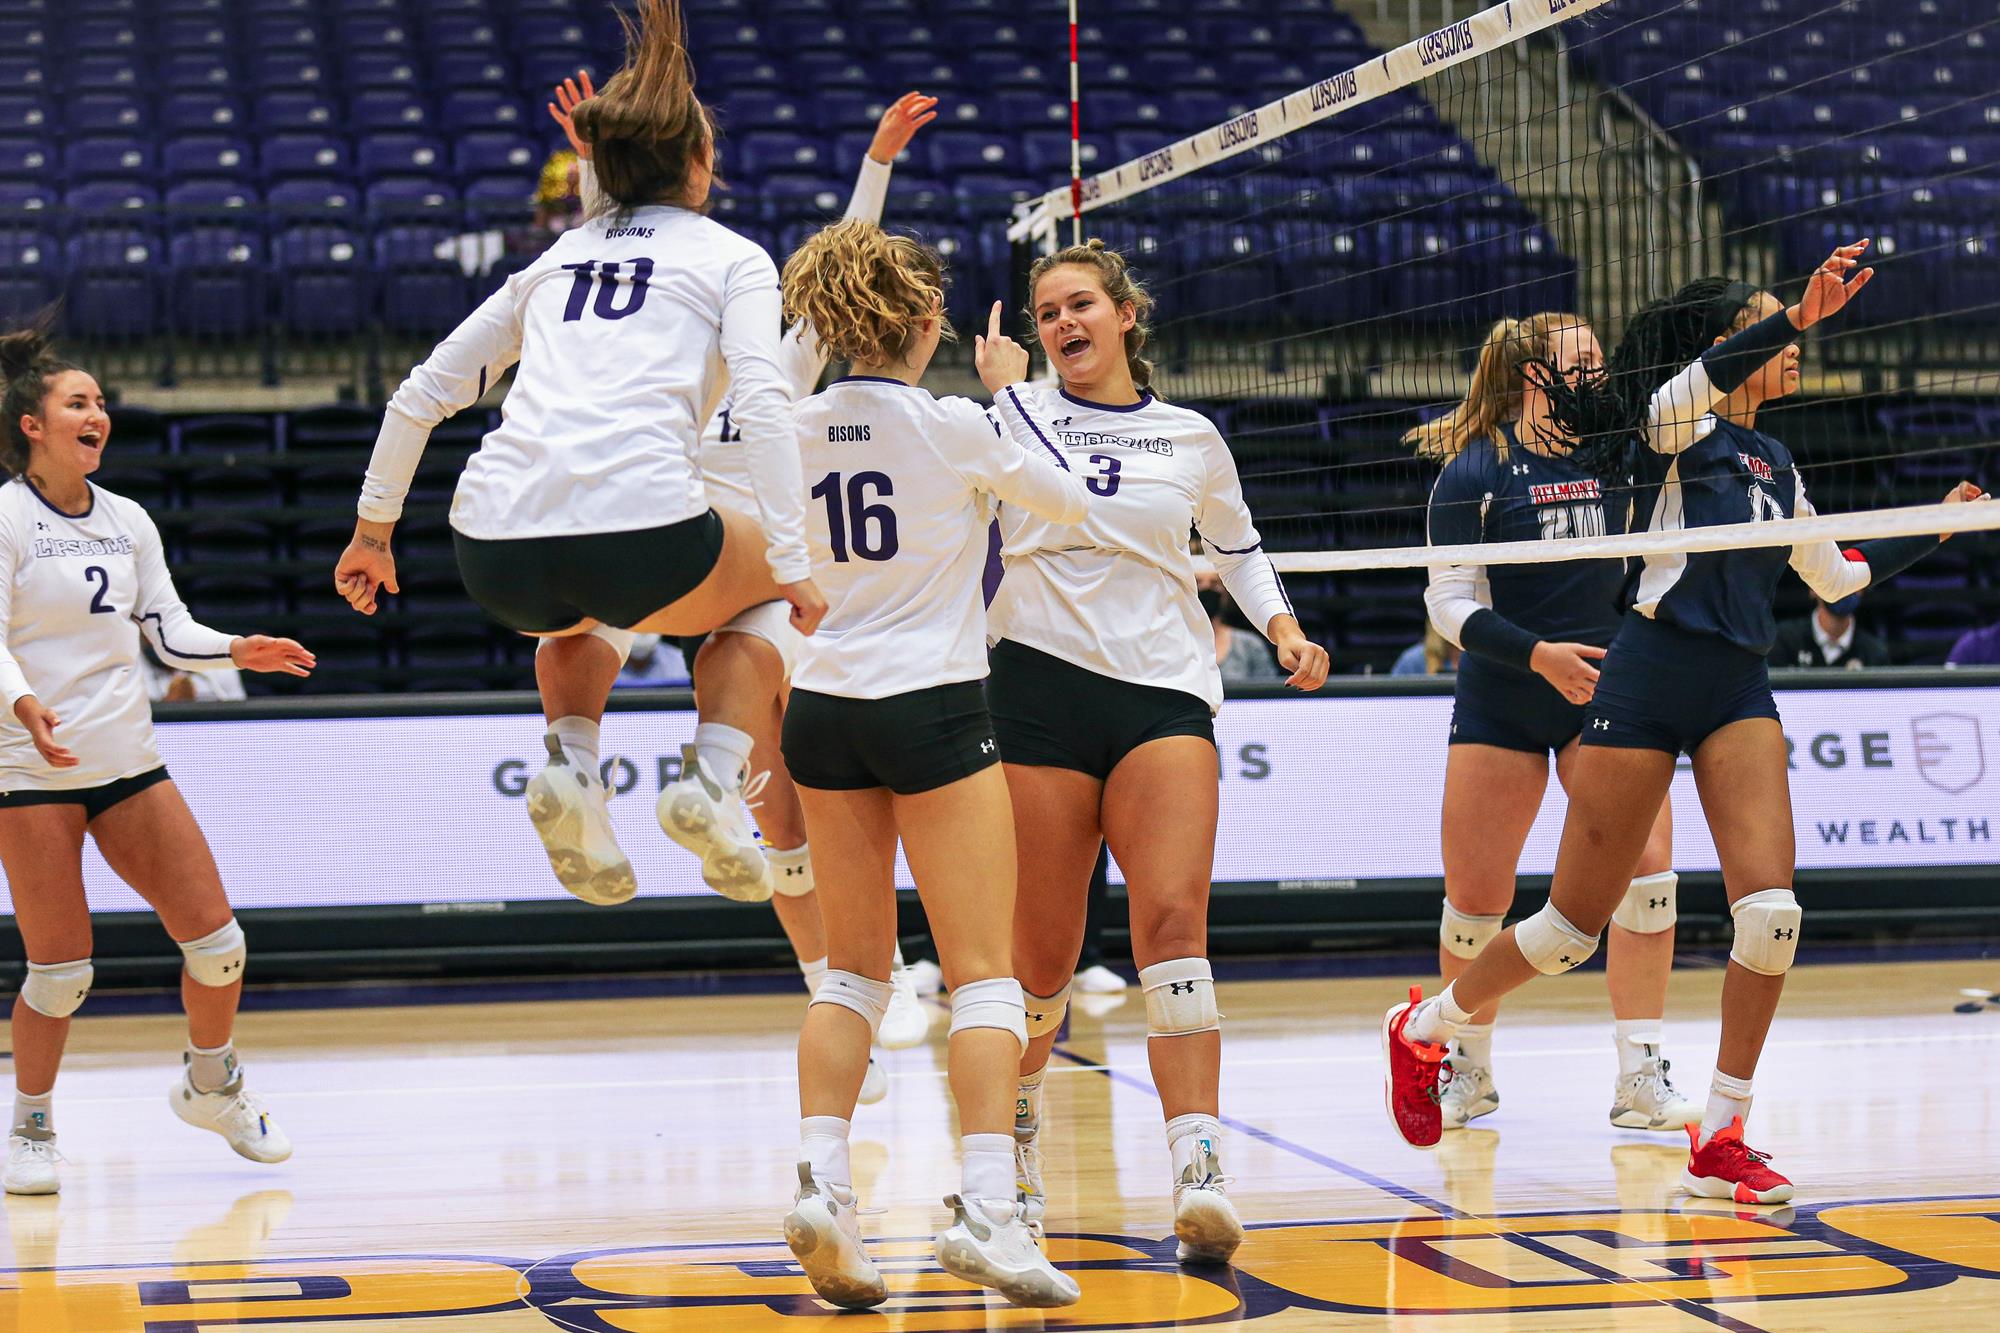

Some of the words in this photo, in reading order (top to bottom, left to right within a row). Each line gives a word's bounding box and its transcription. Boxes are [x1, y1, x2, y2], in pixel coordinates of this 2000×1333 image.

[1416, 20, 1474, 66] LIPSCOMB
[1310, 71, 1357, 112] LIPSCOMB
[1218, 112, 1259, 150] LIPSCOMB
[605, 227, 656, 240] BISONS
[561, 257, 655, 322] 10
[828, 424, 871, 442] BISONS
[1086, 454, 1122, 497] 3
[811, 470, 899, 562] 16
[35, 536, 135, 558] LIPSCOMB
[85, 565, 116, 614] 2
[1817, 818, 1991, 846] WEALTH
